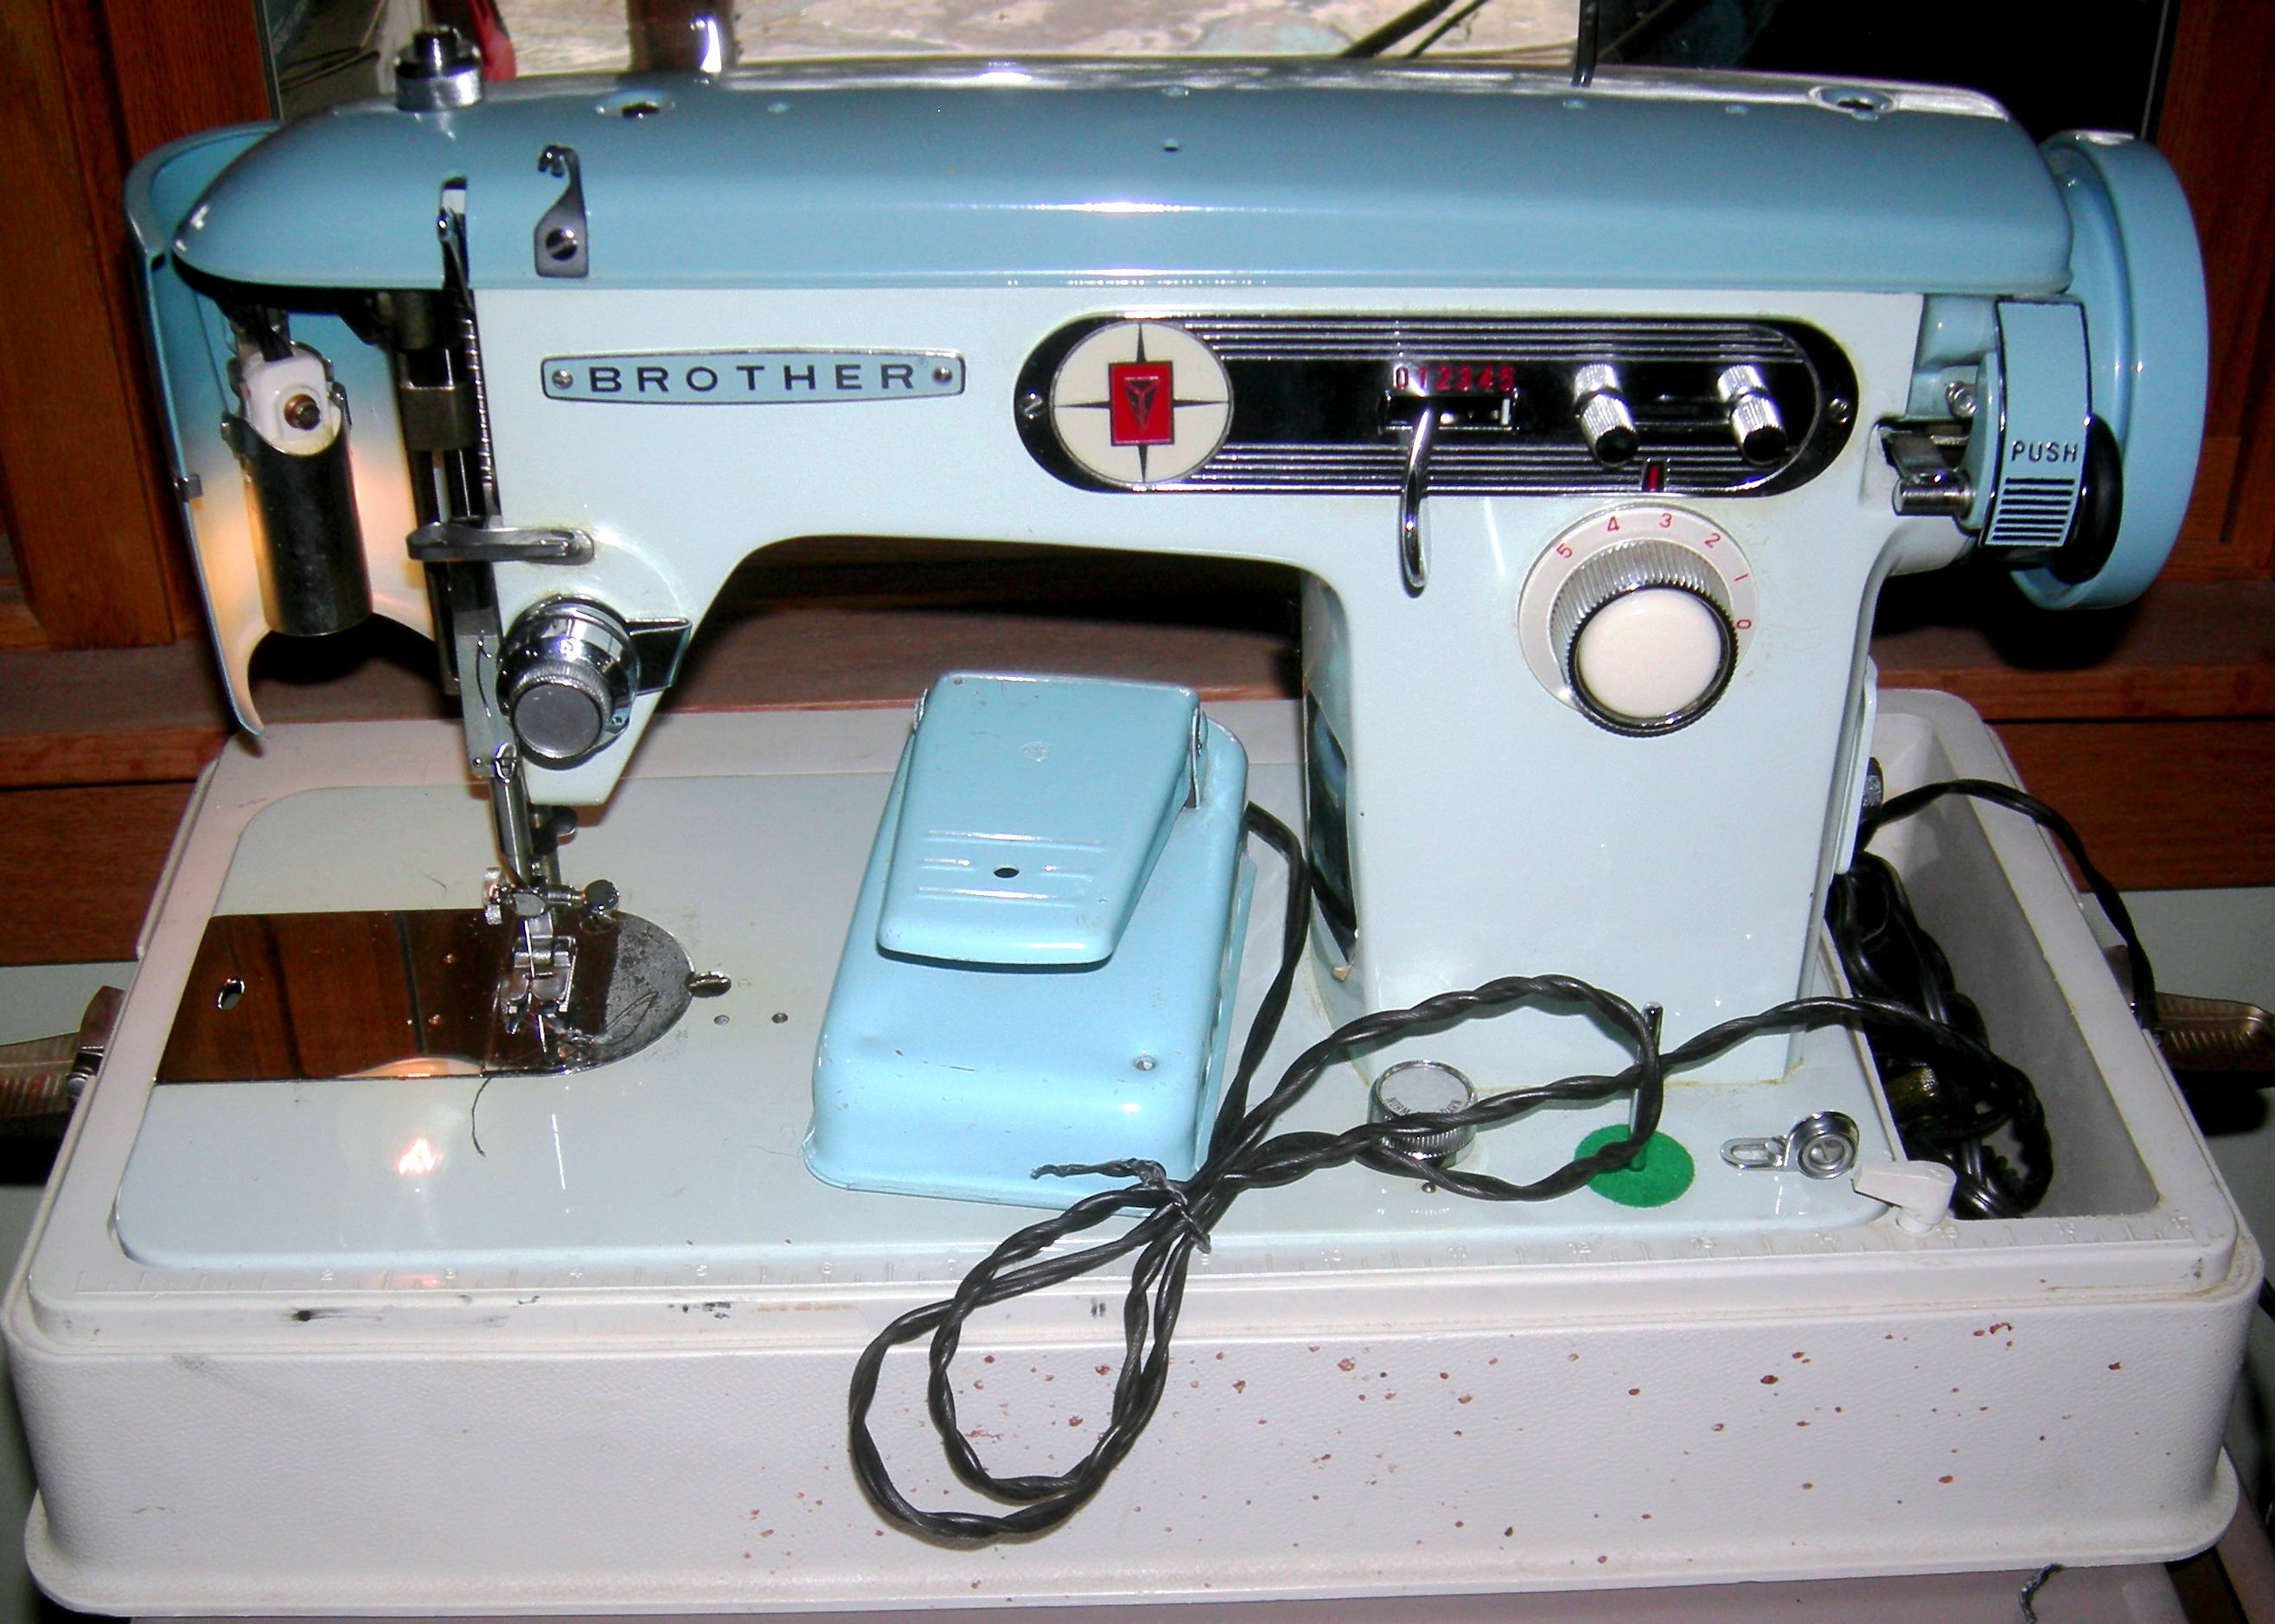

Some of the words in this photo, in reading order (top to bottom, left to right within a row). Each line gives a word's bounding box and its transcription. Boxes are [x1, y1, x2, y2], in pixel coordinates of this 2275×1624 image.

[588, 363, 915, 393] BROTHER
[2010, 440, 2077, 463] PUSH
[1556, 543, 1574, 559] 5
[1607, 516, 1620, 533] 4
[1659, 513, 1673, 529] 3
[1704, 533, 1722, 549] 2
[1735, 618, 1753, 630] 0
